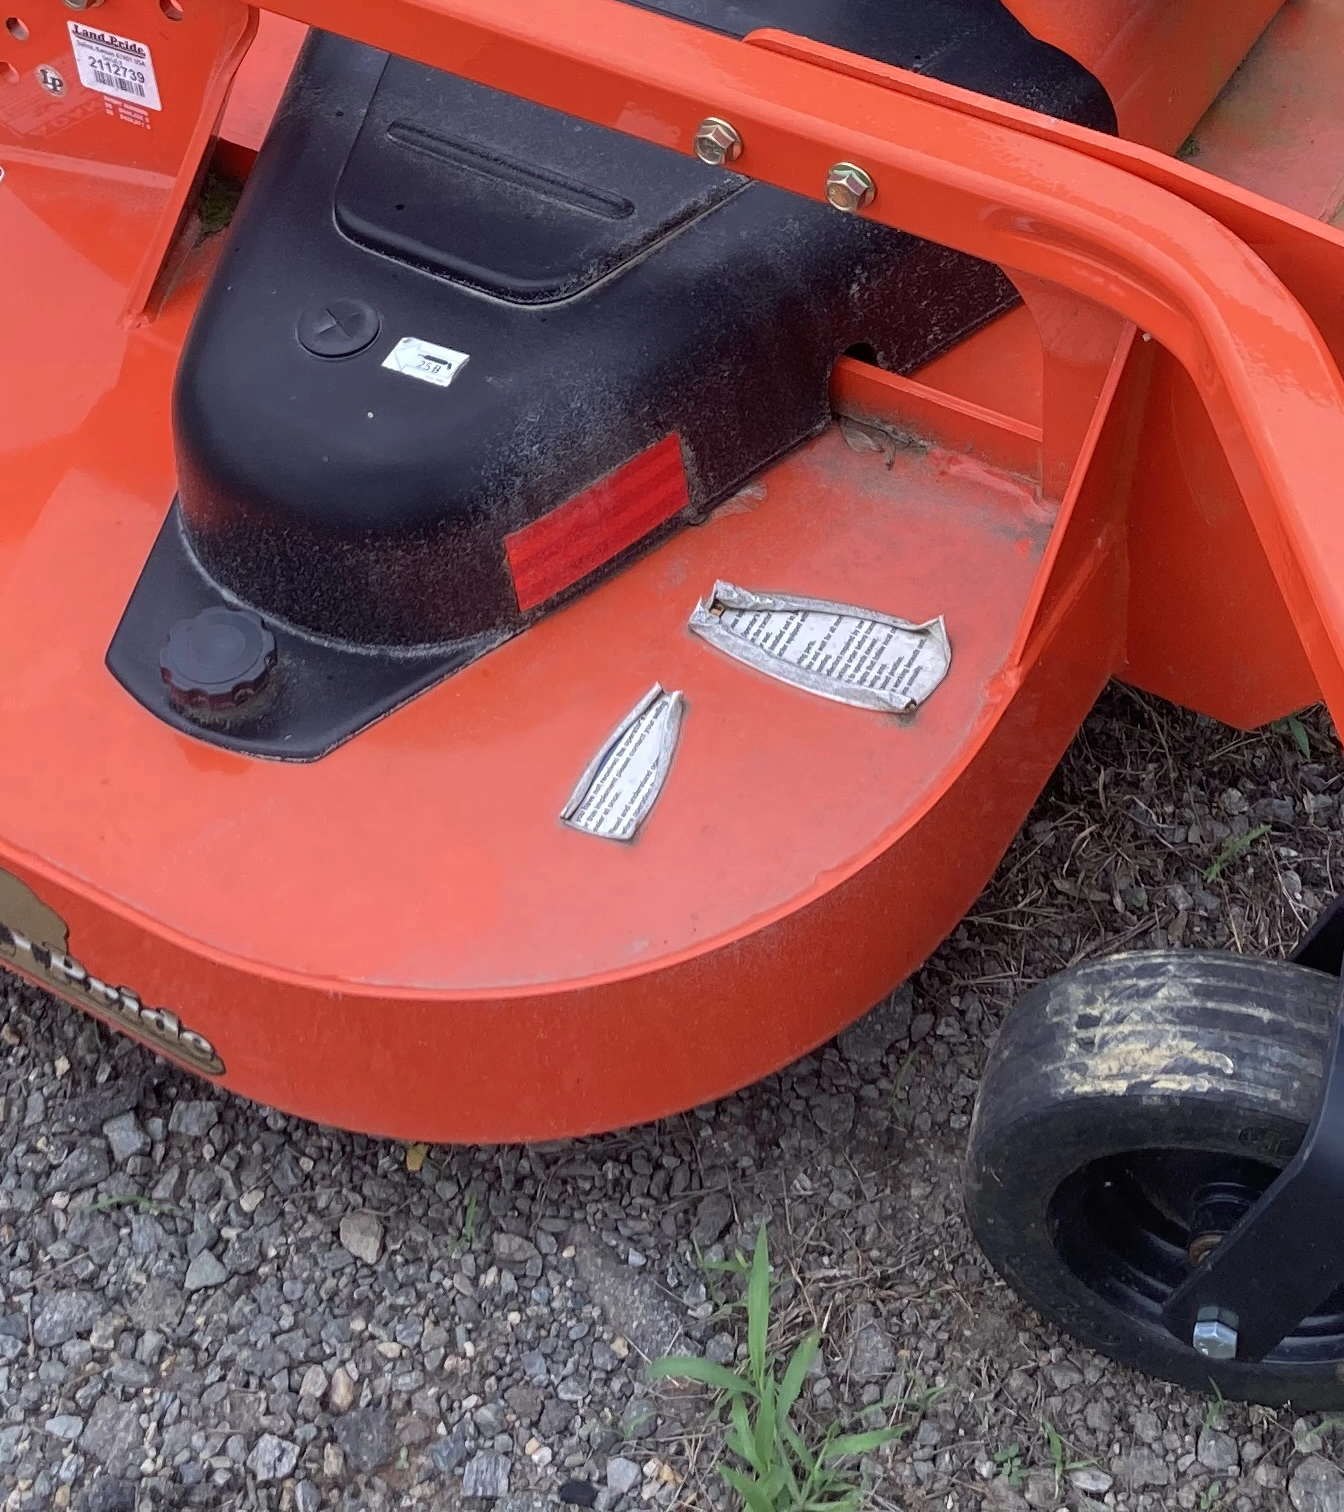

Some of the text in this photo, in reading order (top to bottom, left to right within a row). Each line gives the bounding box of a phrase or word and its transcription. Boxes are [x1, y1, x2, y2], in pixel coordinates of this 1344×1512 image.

[71, 24, 145, 54] Land Pride
[40, 69, 64, 93] LP
[88, 56, 144, 83] 2112739
